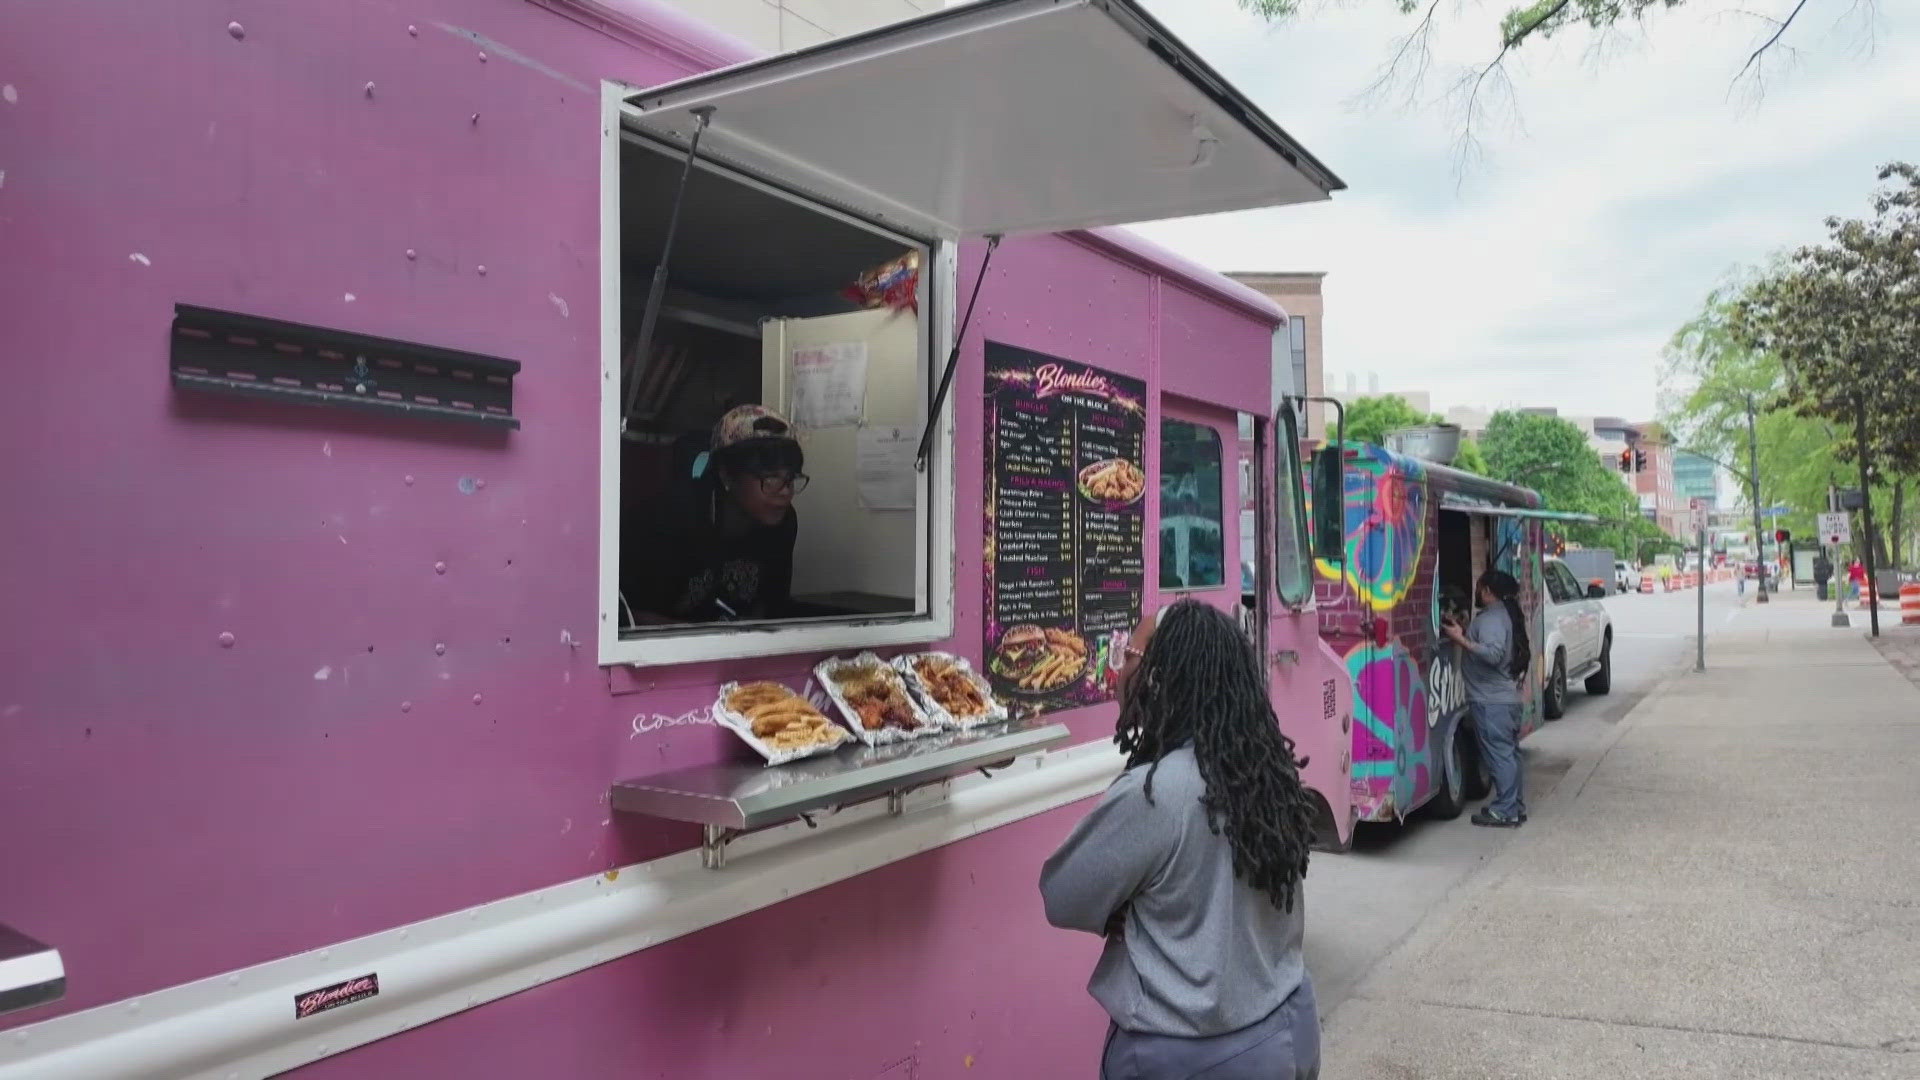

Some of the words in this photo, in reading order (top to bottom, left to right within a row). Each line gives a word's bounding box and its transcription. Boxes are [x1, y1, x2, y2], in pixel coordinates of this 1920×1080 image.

[1036, 363, 1108, 394] Blondies
[1061, 394, 1073, 404] ON
[1074, 396, 1086, 407] THE
[1087, 399, 1109, 412] BLOCK
[300, 978, 375, 1014] Blondies
